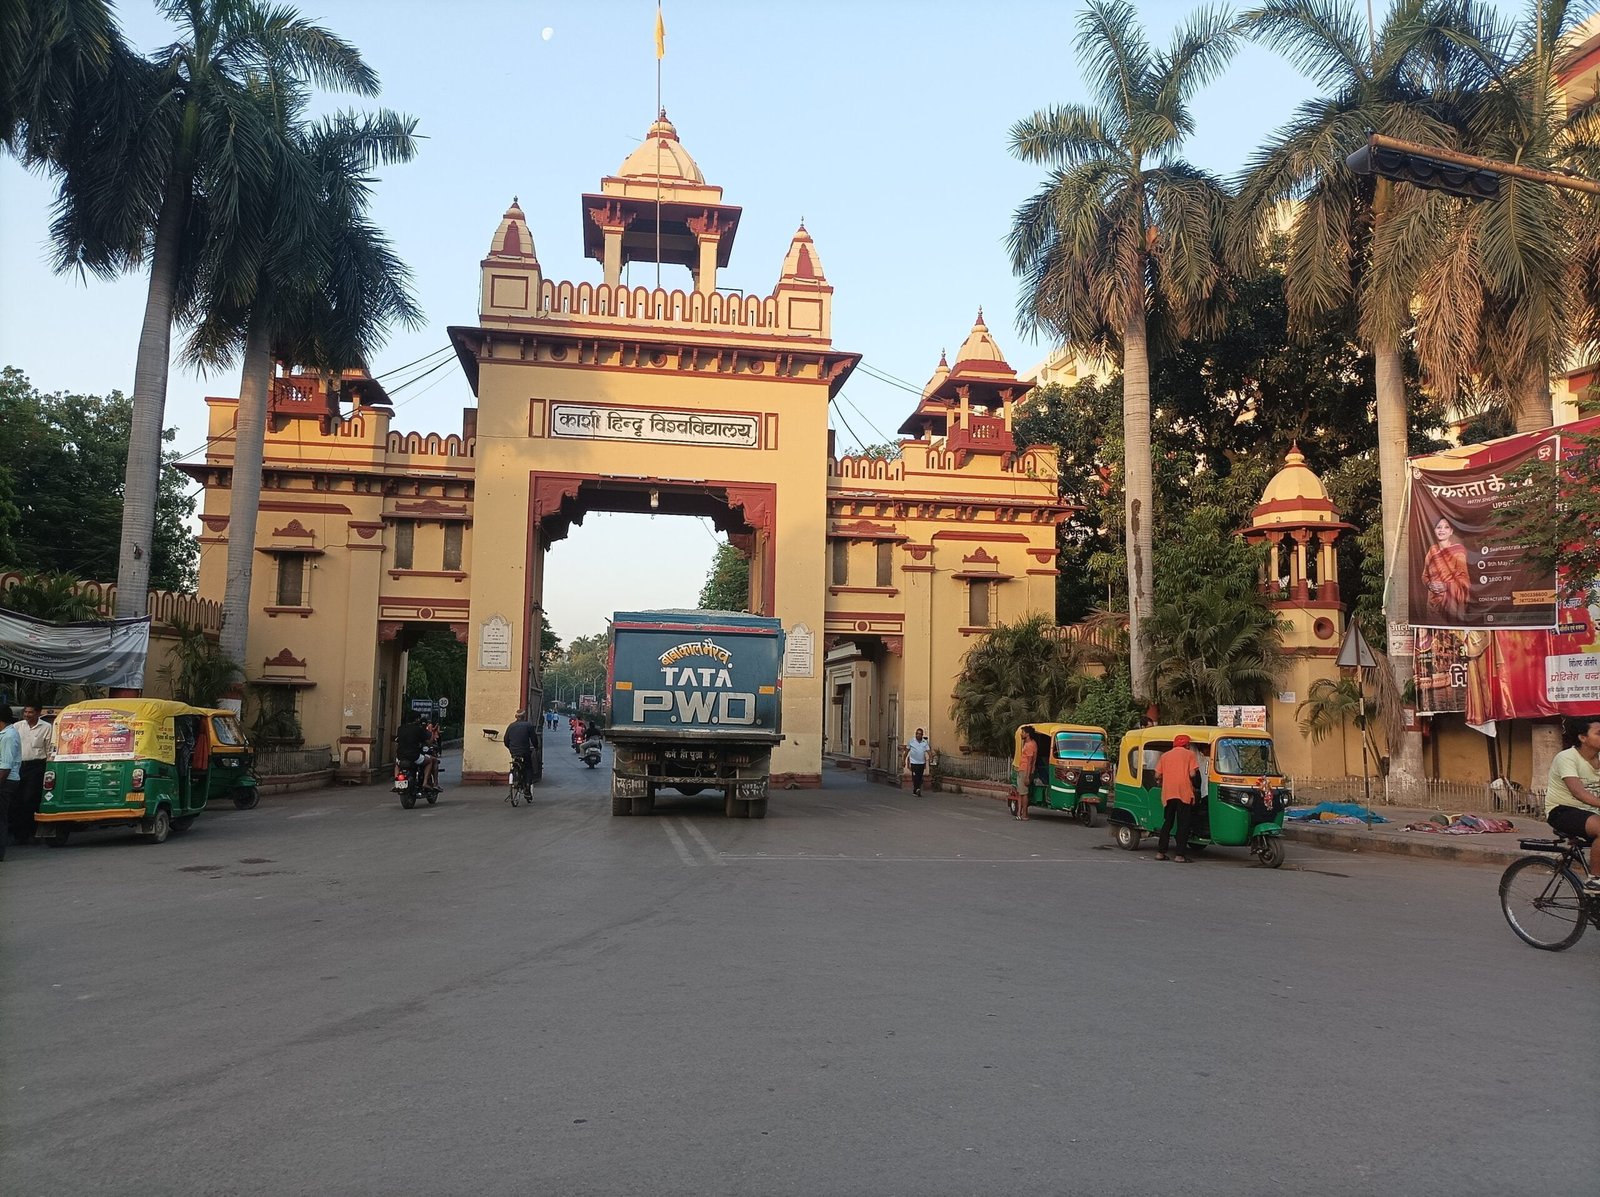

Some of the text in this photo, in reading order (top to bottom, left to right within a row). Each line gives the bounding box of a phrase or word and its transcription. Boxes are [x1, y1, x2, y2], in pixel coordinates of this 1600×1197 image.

[559, 410, 752, 438] काशी हिन्दू विश्वविद्यालय
[661, 667, 733, 687] TATA
